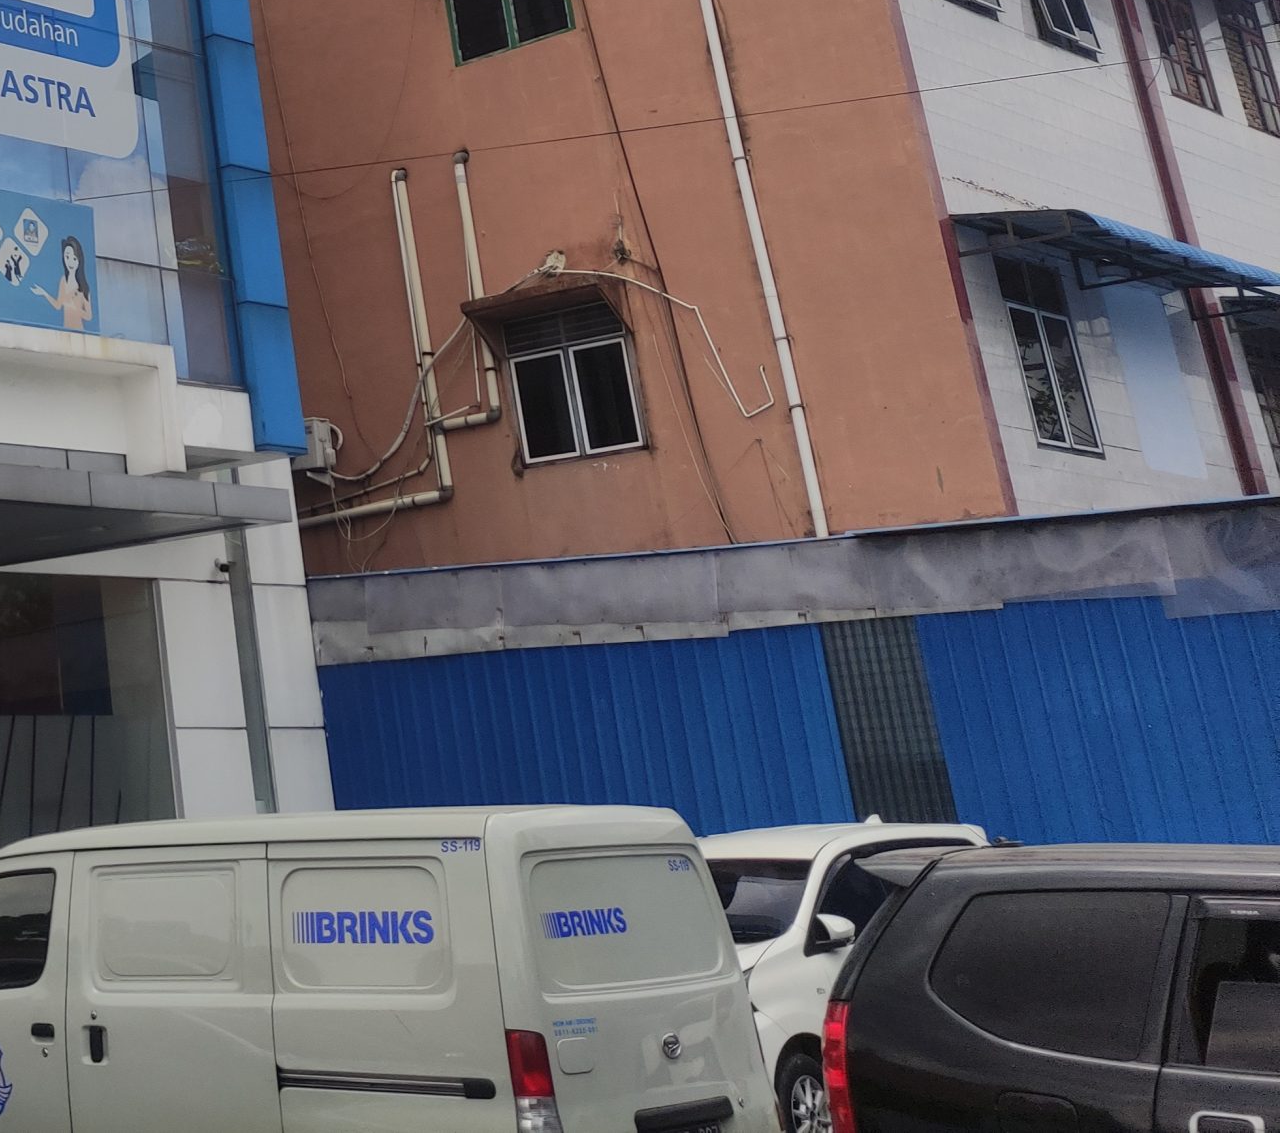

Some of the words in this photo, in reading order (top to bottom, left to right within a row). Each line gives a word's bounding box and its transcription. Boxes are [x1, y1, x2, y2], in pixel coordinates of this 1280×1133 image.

[0, 69, 97, 118] ASTRA
[441, 838, 480, 853] SS-119
[668, 859, 690, 871] SS-119
[314, 910, 435, 944] BRINKS
[555, 906, 627, 938] BRINKS
